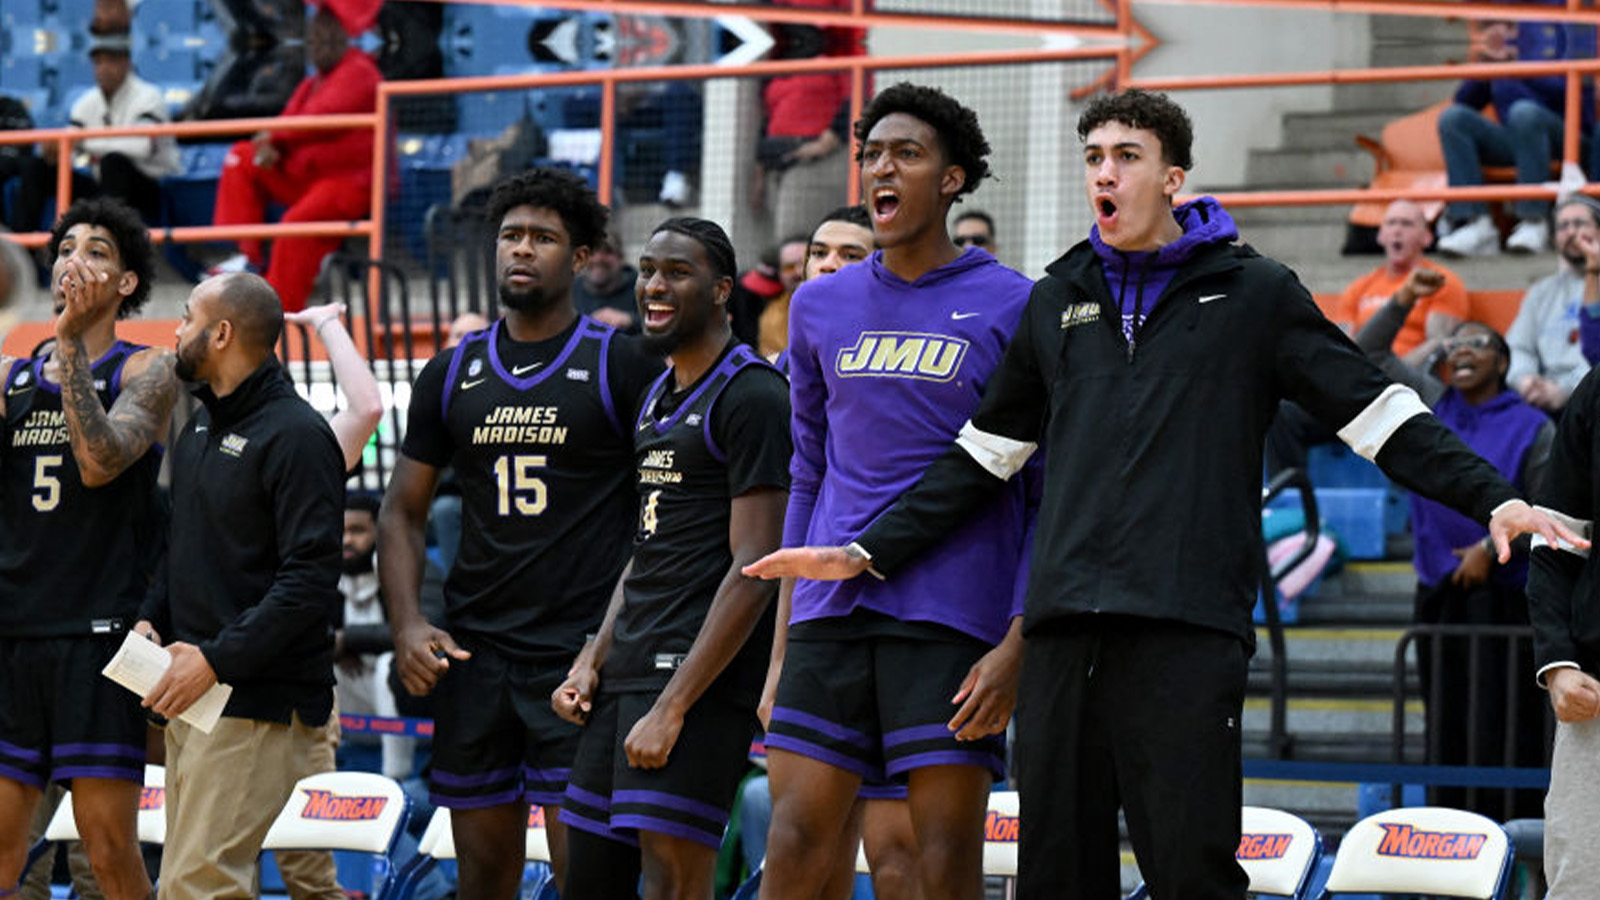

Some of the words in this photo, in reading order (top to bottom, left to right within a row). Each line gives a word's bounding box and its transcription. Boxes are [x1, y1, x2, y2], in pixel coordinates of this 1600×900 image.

[839, 336, 962, 377] JMU
[24, 410, 67, 428] JAM
[484, 405, 559, 424] JAMES
[12, 426, 70, 447] MADIS
[471, 425, 569, 445] MADISON
[32, 454, 63, 512] 5
[493, 454, 549, 516] 15
[302, 790, 388, 820] MORGAN
[1237, 834, 1293, 859] RGAN
[1379, 824, 1486, 858] MORGAN
